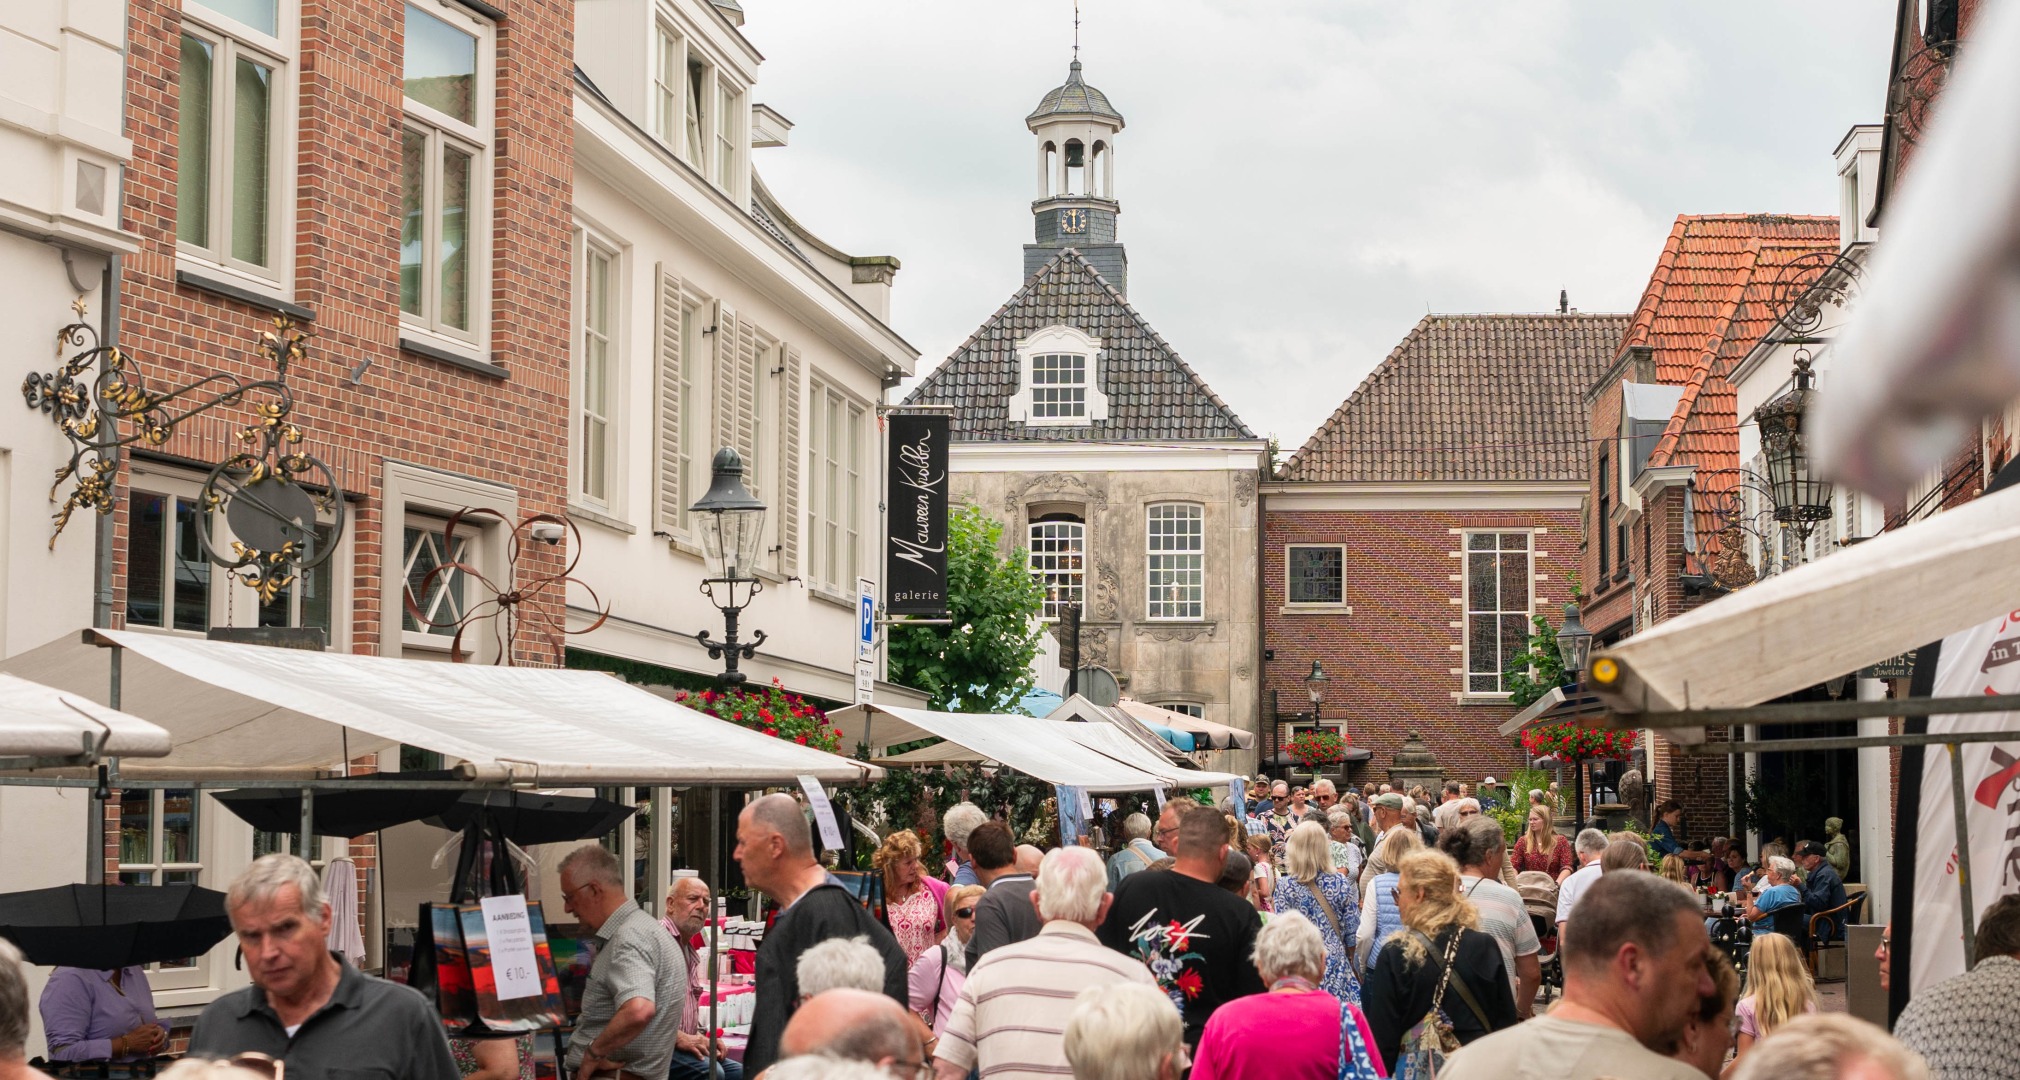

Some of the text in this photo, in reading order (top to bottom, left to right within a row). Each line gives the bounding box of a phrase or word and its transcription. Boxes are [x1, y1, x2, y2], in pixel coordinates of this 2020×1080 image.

[890, 428, 945, 575] Maureen Knobben
[894, 590, 939, 601] galerie
[863, 602, 871, 637] P
[1991, 645, 2010, 662] in
[1873, 667, 1914, 677] Juwelen &
[506, 967, 513, 981] €
